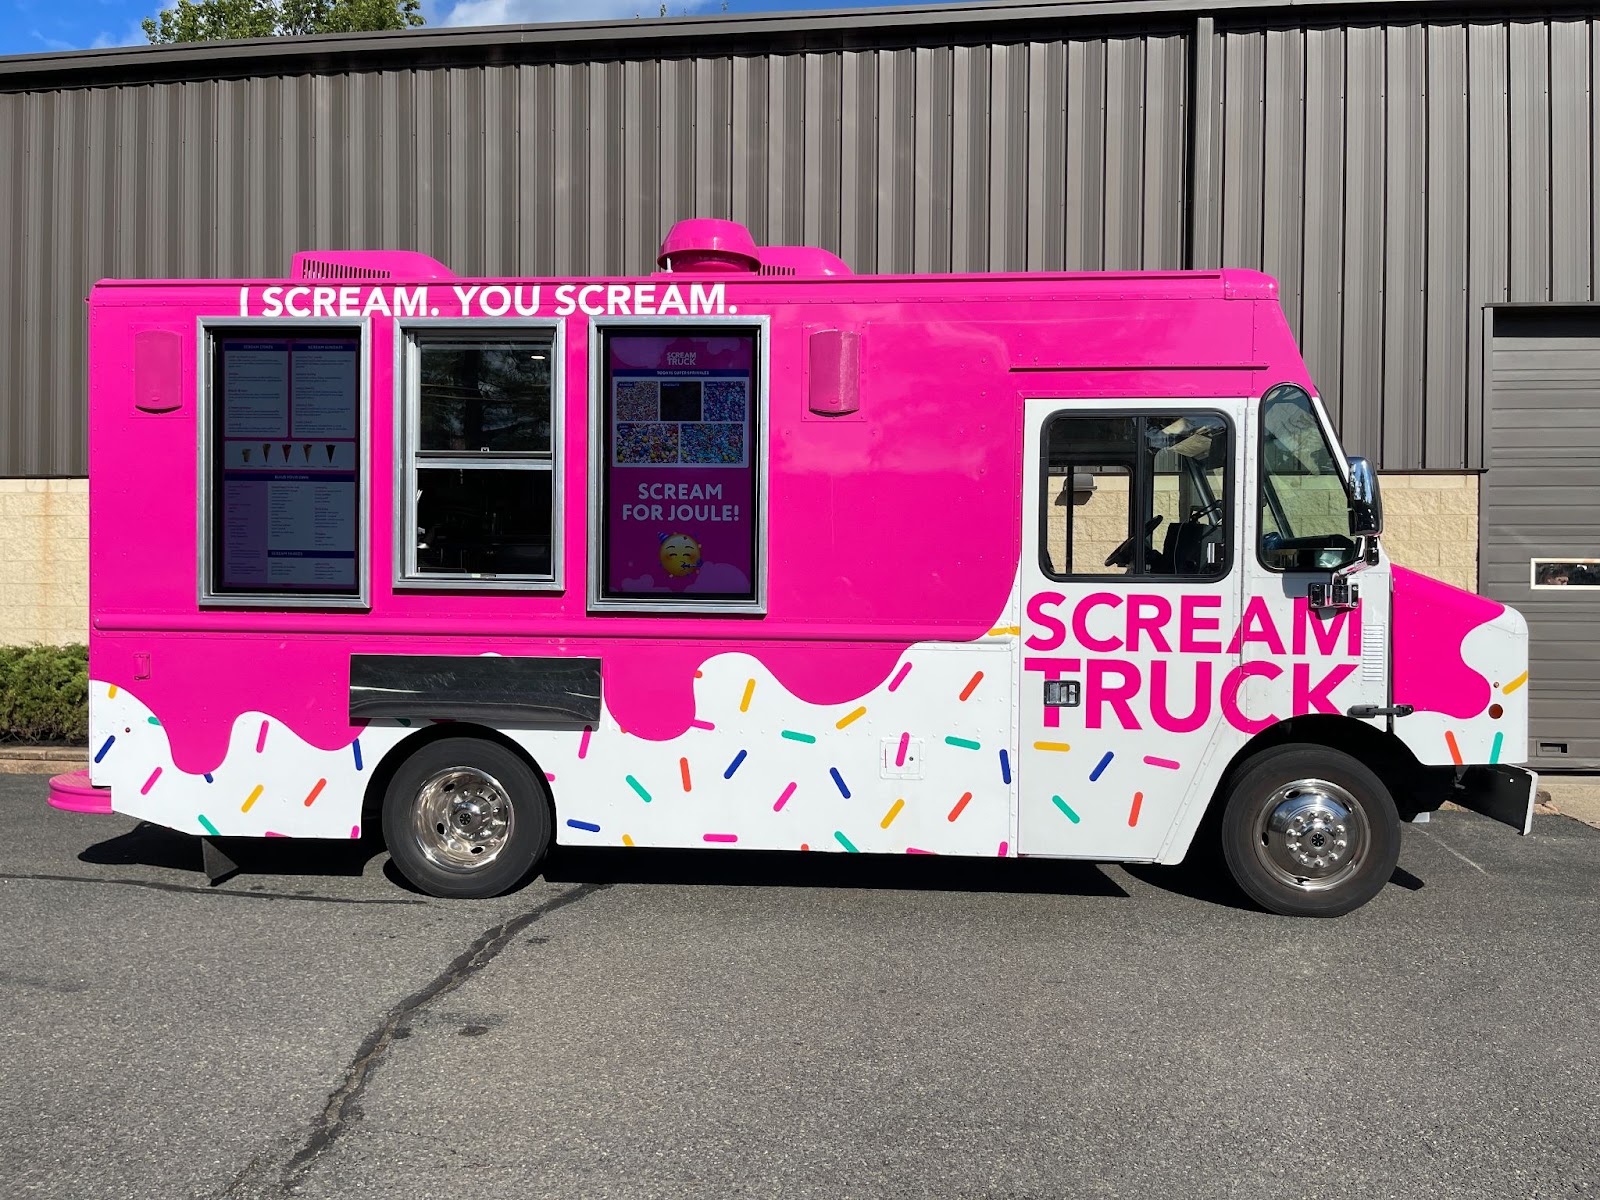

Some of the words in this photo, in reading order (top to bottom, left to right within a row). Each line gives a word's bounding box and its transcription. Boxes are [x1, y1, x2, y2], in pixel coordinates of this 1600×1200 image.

[240, 286, 249, 316] I
[262, 285, 440, 317] SCREAM.
[455, 284, 541, 316] YOU
[555, 284, 738, 316] SCREAM.
[667, 358, 697, 366] TRUCK
[638, 483, 723, 500] SCREAM
[622, 504, 664, 521] FOR
[667, 504, 740, 521] JOULE!
[1024, 591, 1363, 656] SCREAM
[1024, 657, 1360, 735] TRUCK
